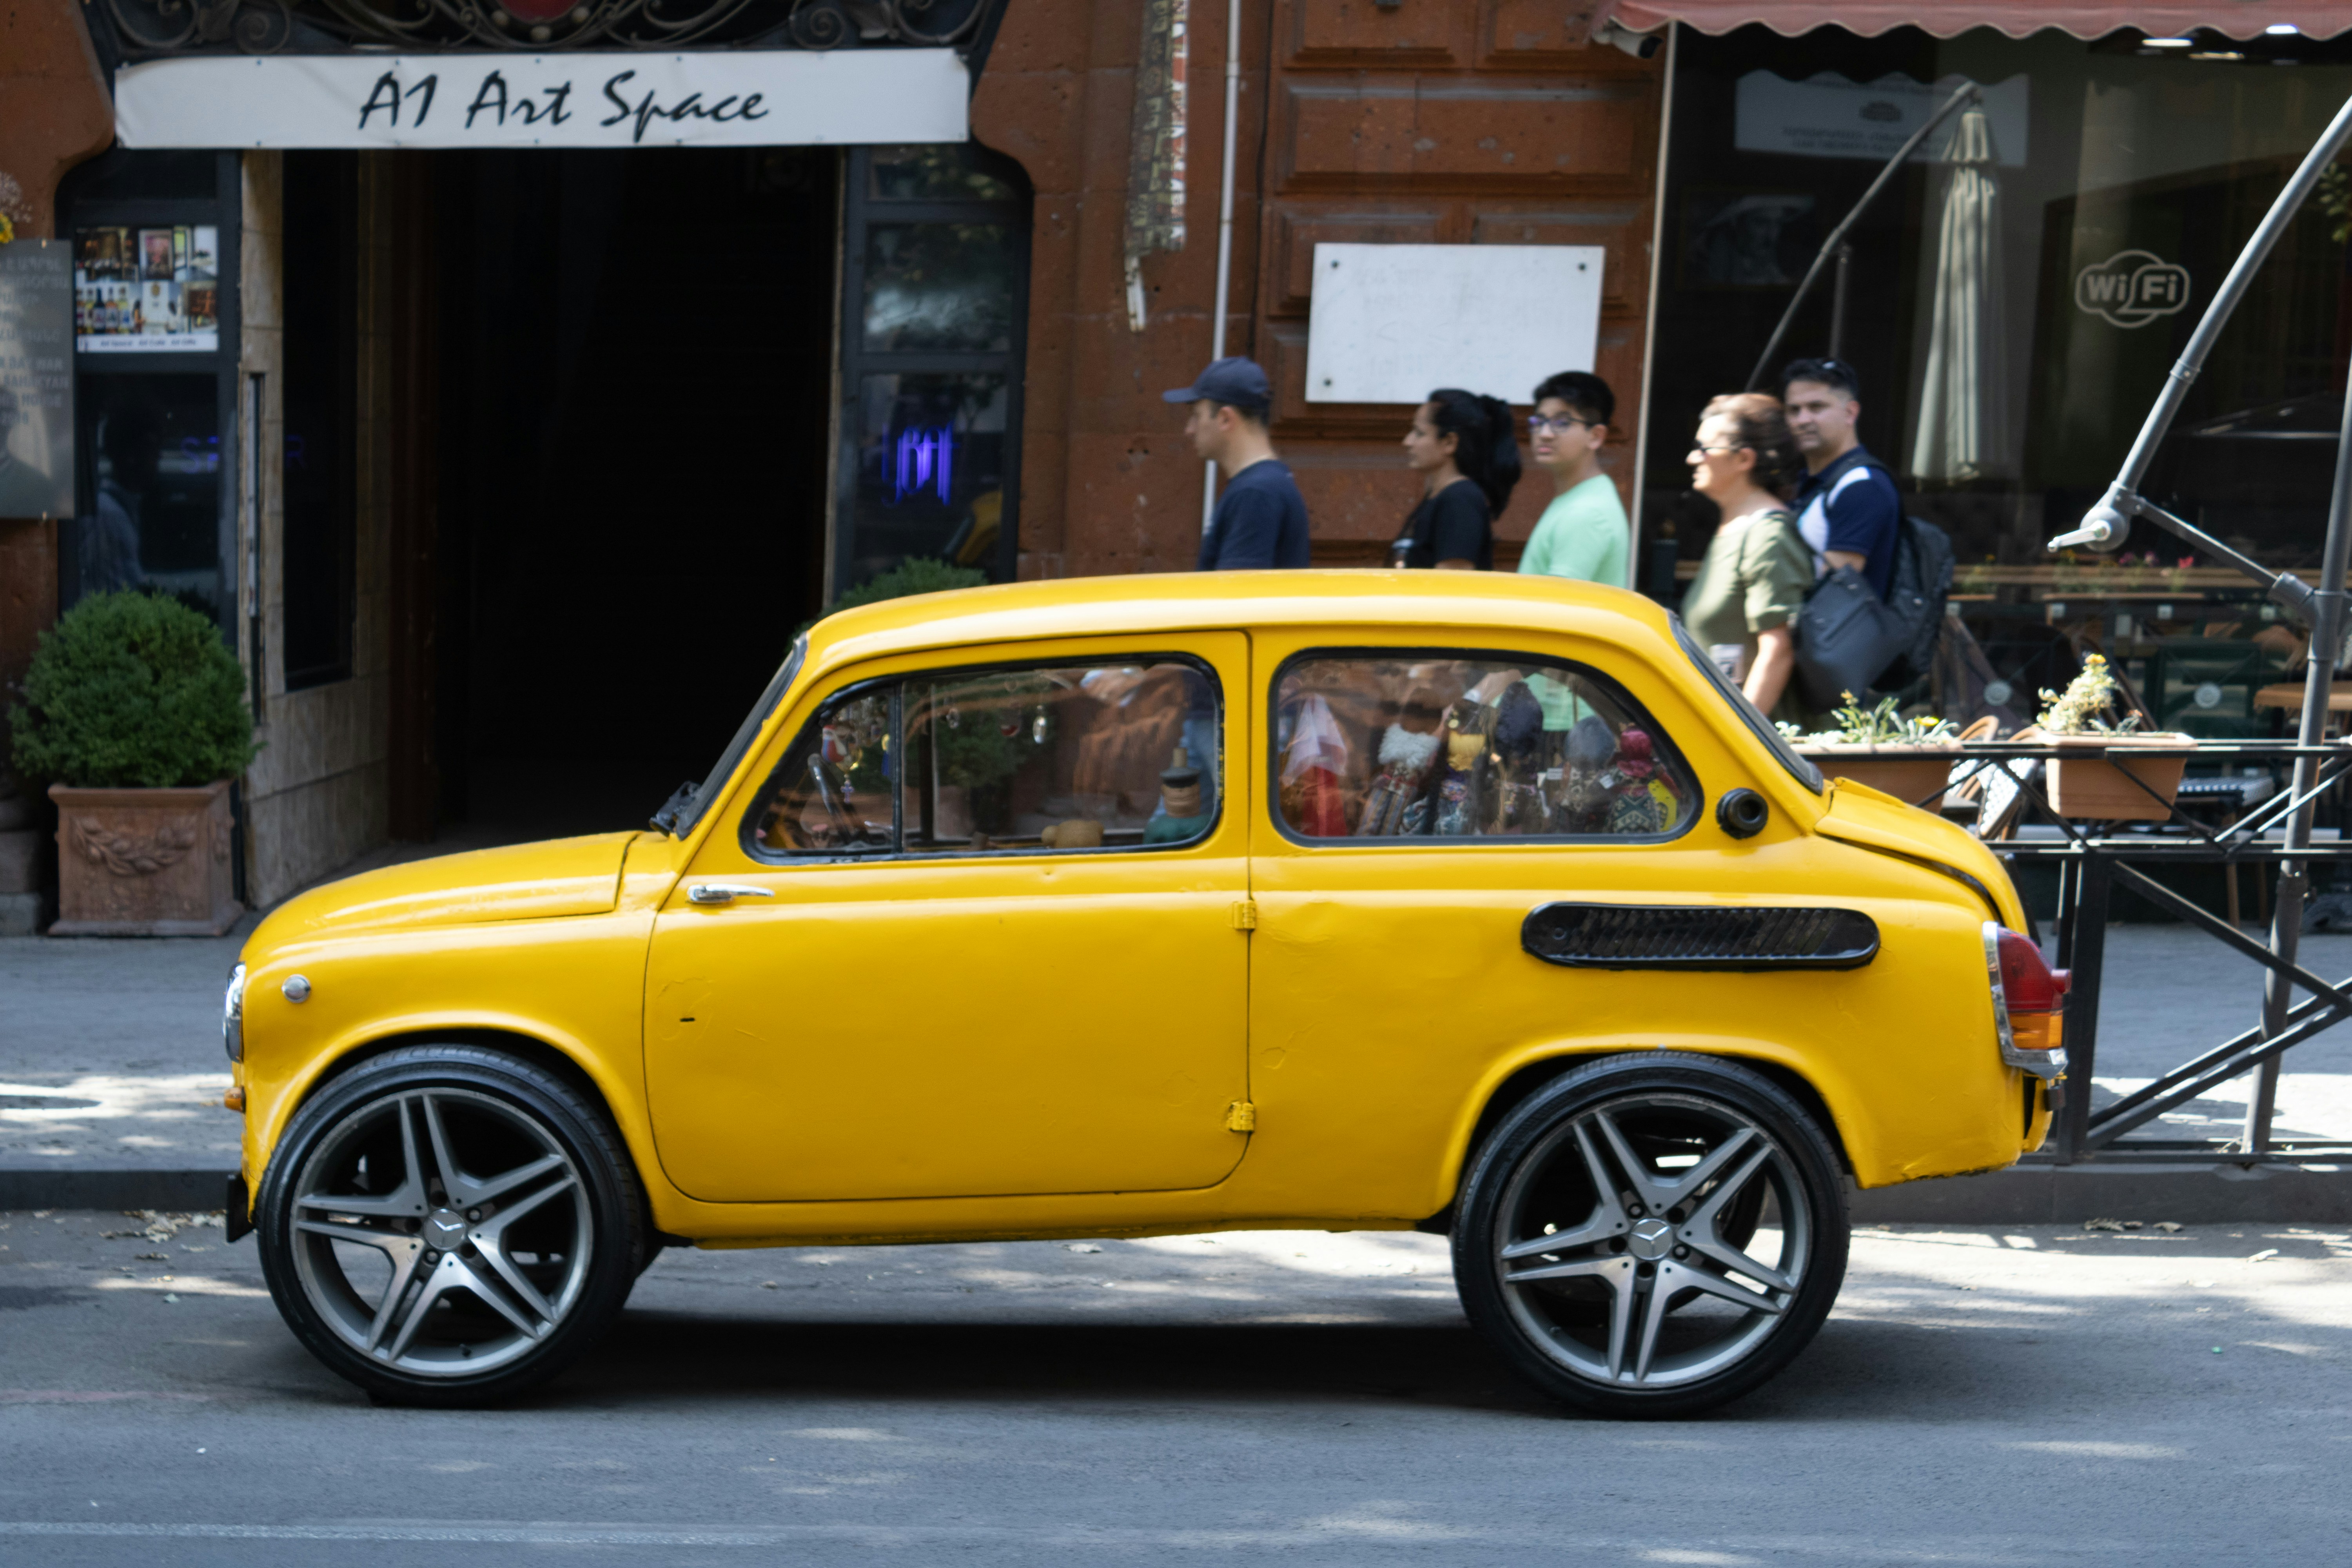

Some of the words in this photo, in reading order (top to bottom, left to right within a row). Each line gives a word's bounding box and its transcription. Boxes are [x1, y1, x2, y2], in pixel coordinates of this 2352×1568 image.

[358, 69, 438, 130] A1
[465, 69, 572, 129] Art
[599, 69, 769, 143] Space
